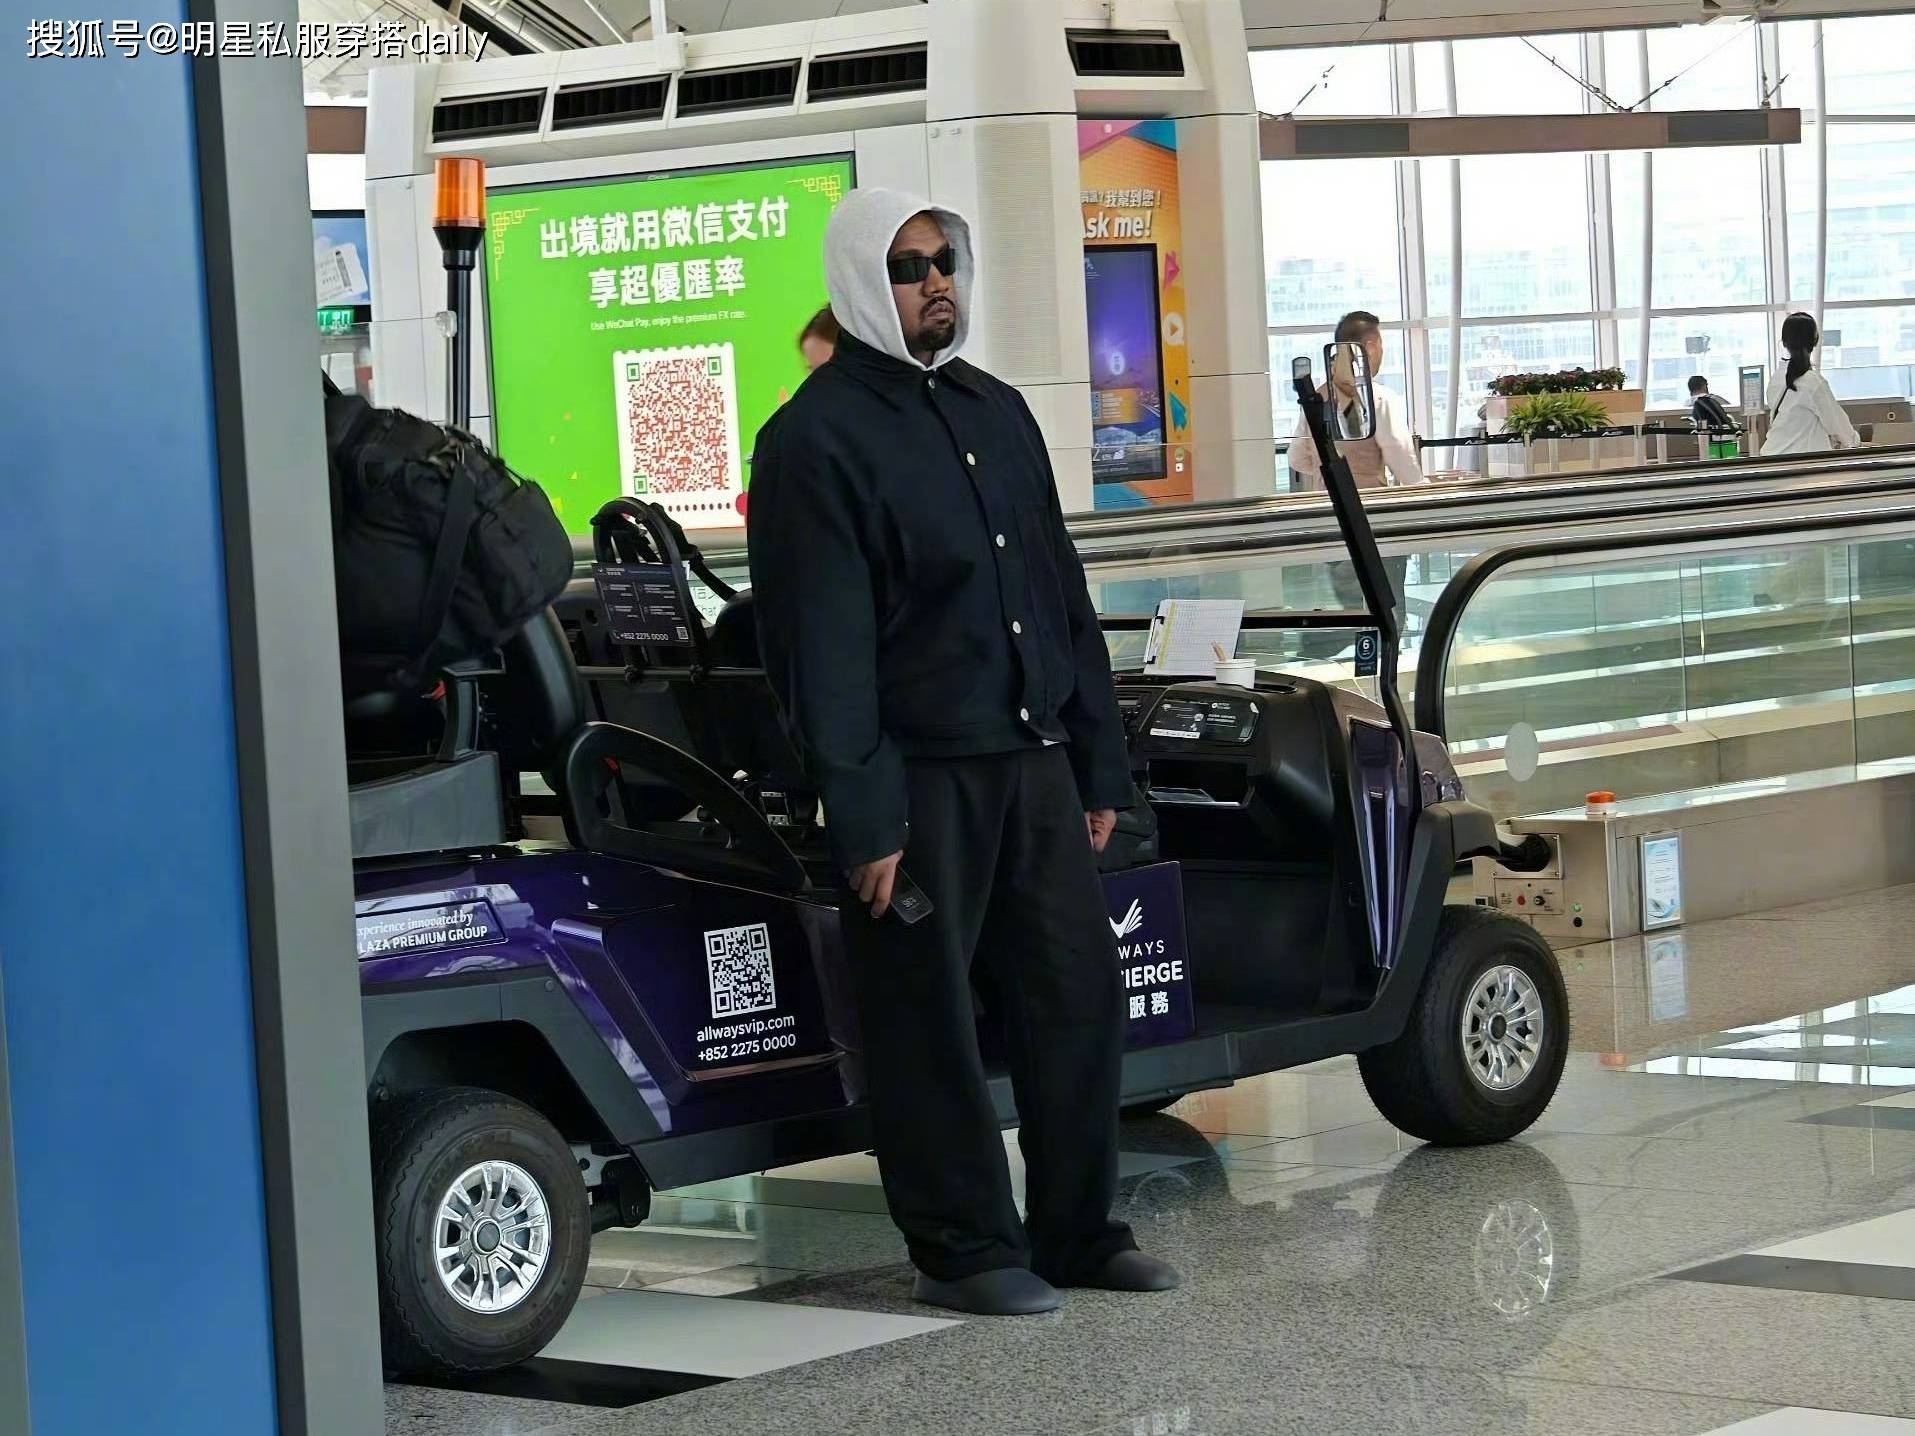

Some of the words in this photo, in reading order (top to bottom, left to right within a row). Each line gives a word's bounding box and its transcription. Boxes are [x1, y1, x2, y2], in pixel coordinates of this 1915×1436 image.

[539, 196, 789, 259] 出境就用微信支付
[1114, 210, 1152, 238] me!
[588, 255, 746, 308] 享超優匯率
[606, 319, 634, 329] WeChat
[652, 316, 671, 326] enjoy
[672, 315, 685, 323] the
[685, 312, 717, 324] premium
[1362, 639, 1370, 650] 6
[407, 914, 459, 930] innovated
[460, 909, 473, 927] by
[393, 931, 446, 949] PREMIUM
[448, 925, 488, 945] GROUP
[1121, 960, 1184, 988] IERGE
[1129, 990, 1169, 1019] 服務
[696, 1015, 795, 1043] allwaysvip.com
[698, 1046, 728, 1061] +852
[731, 1039, 760, 1057] 2275
[762, 1033, 796, 1051] 0000
